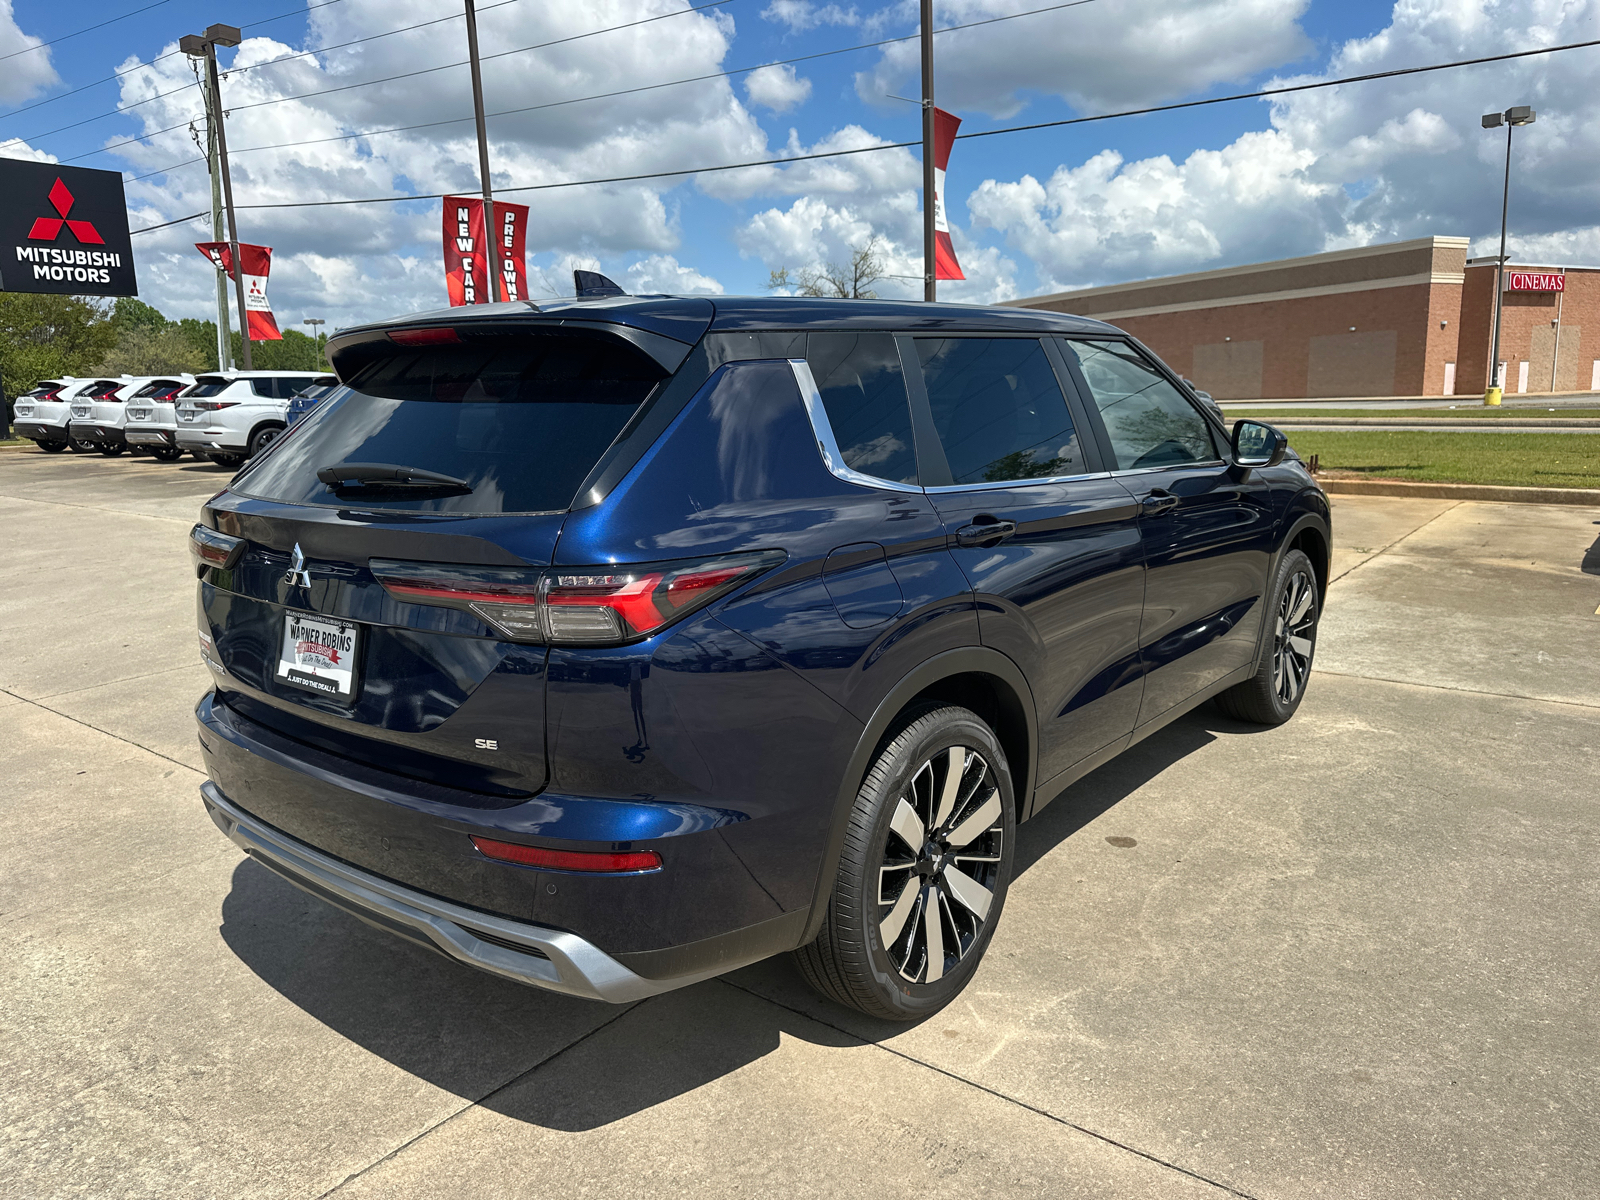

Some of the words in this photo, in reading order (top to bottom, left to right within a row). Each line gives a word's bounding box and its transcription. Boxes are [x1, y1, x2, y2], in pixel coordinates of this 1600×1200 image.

[456, 208, 473, 252] NEW
[16, 246, 121, 268] MITSUBISHI
[33, 265, 110, 283] MOTORS
[463, 258, 475, 305] CAR
[1512, 274, 1563, 290] CINEMAS
[291, 624, 320, 645] WARNER
[322, 631, 352, 652] ROBINS
[303, 643, 333, 658] MITSUBISHI
[291, 676, 302, 684] JUST
[309, 680, 318, 688] THE
[475, 738, 498, 750] SE
